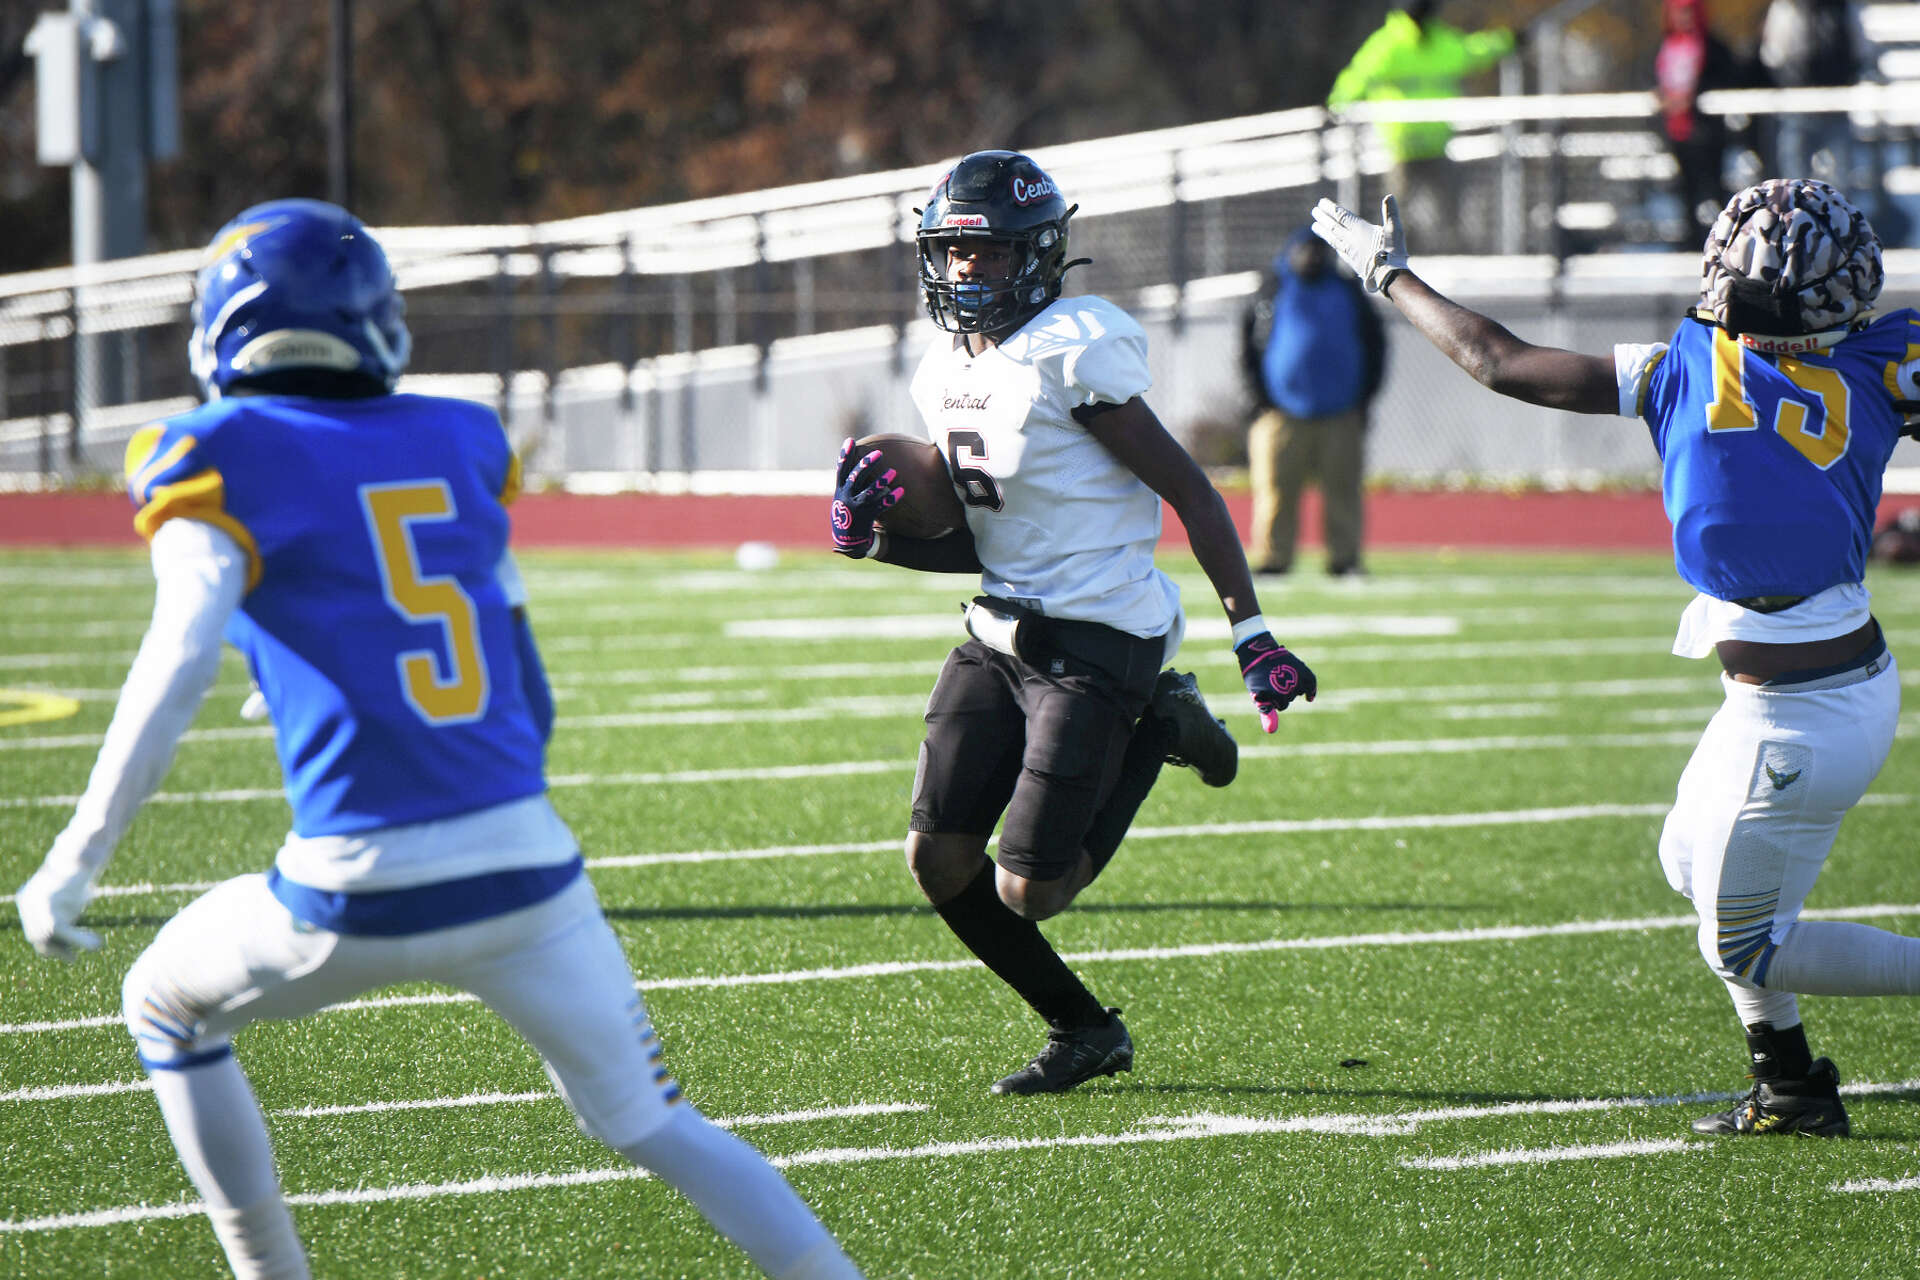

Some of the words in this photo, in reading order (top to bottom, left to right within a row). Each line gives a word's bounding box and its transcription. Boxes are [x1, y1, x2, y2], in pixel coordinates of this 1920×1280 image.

[1743, 333, 1819, 352] Riddell
[942, 391, 992, 411] entral
[947, 427, 1006, 513] 6
[357, 481, 491, 727] 5
